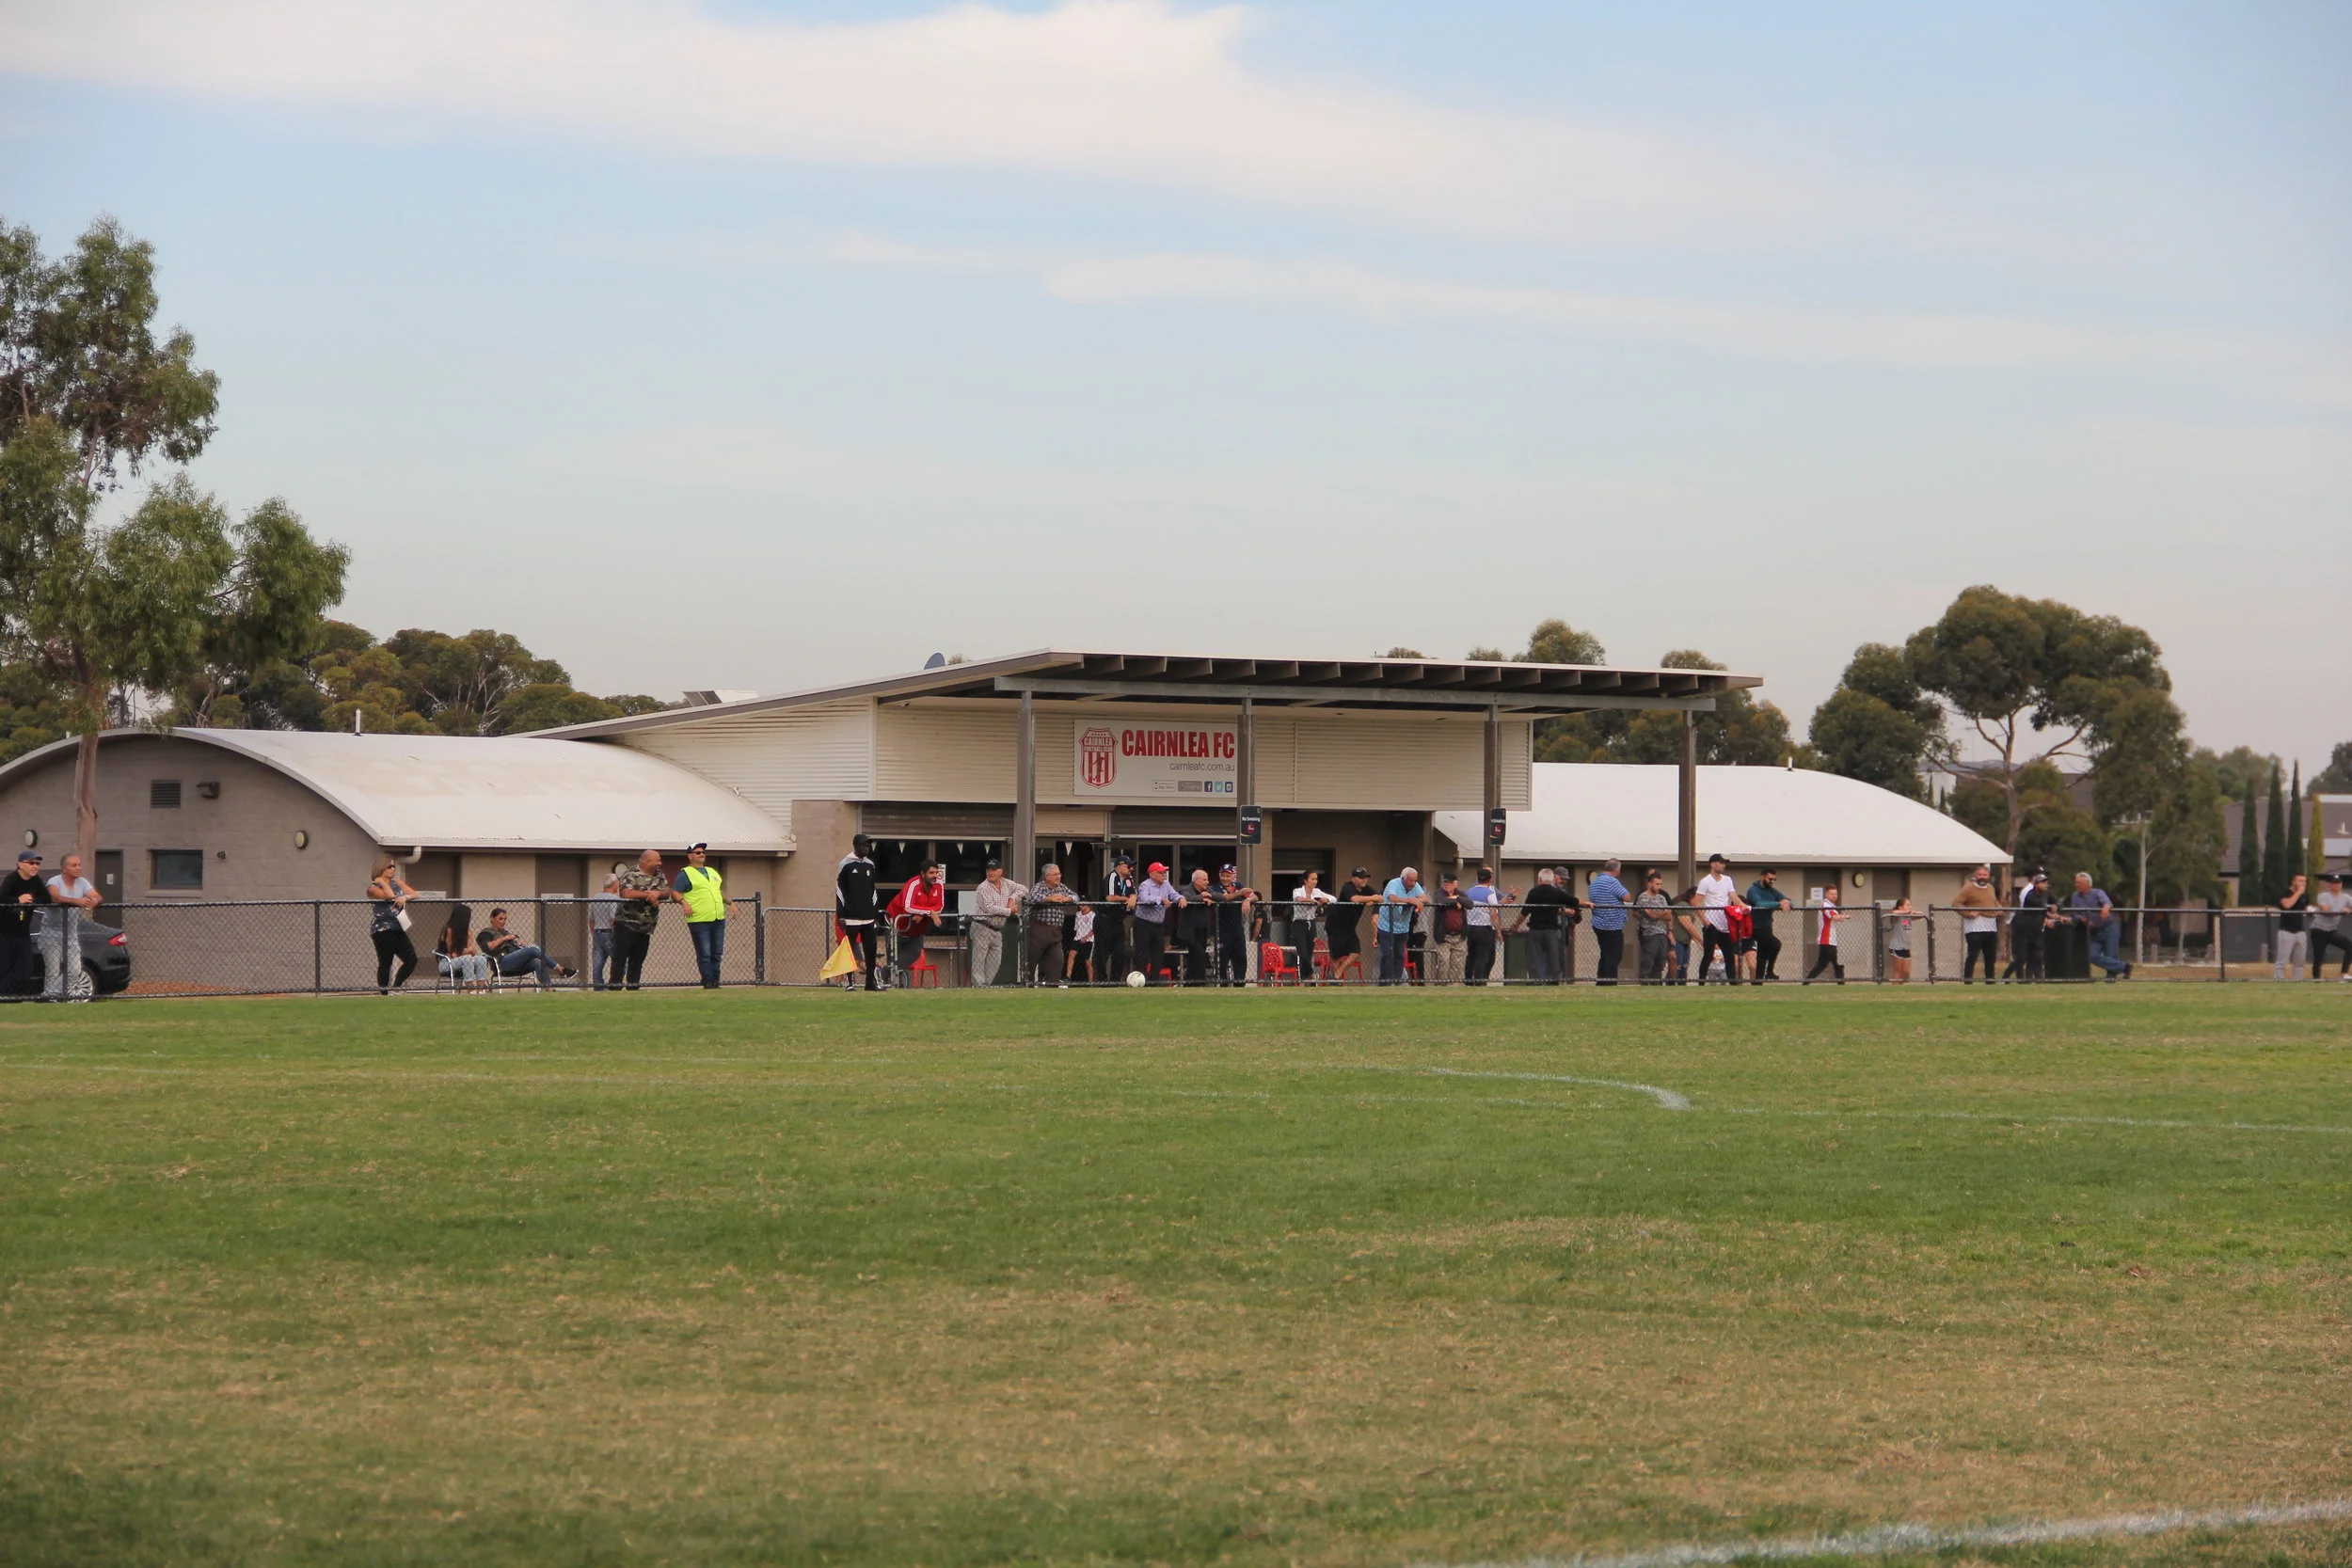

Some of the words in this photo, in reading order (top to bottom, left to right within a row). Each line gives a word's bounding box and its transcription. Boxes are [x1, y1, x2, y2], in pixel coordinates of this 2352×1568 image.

[1084, 736, 1112, 746] CAIRNLEA
[1121, 729, 1210, 758] CAIRNLEA
[1213, 732, 1234, 759] FC
[1169, 761, 1234, 772] cairnleafc.com.au
